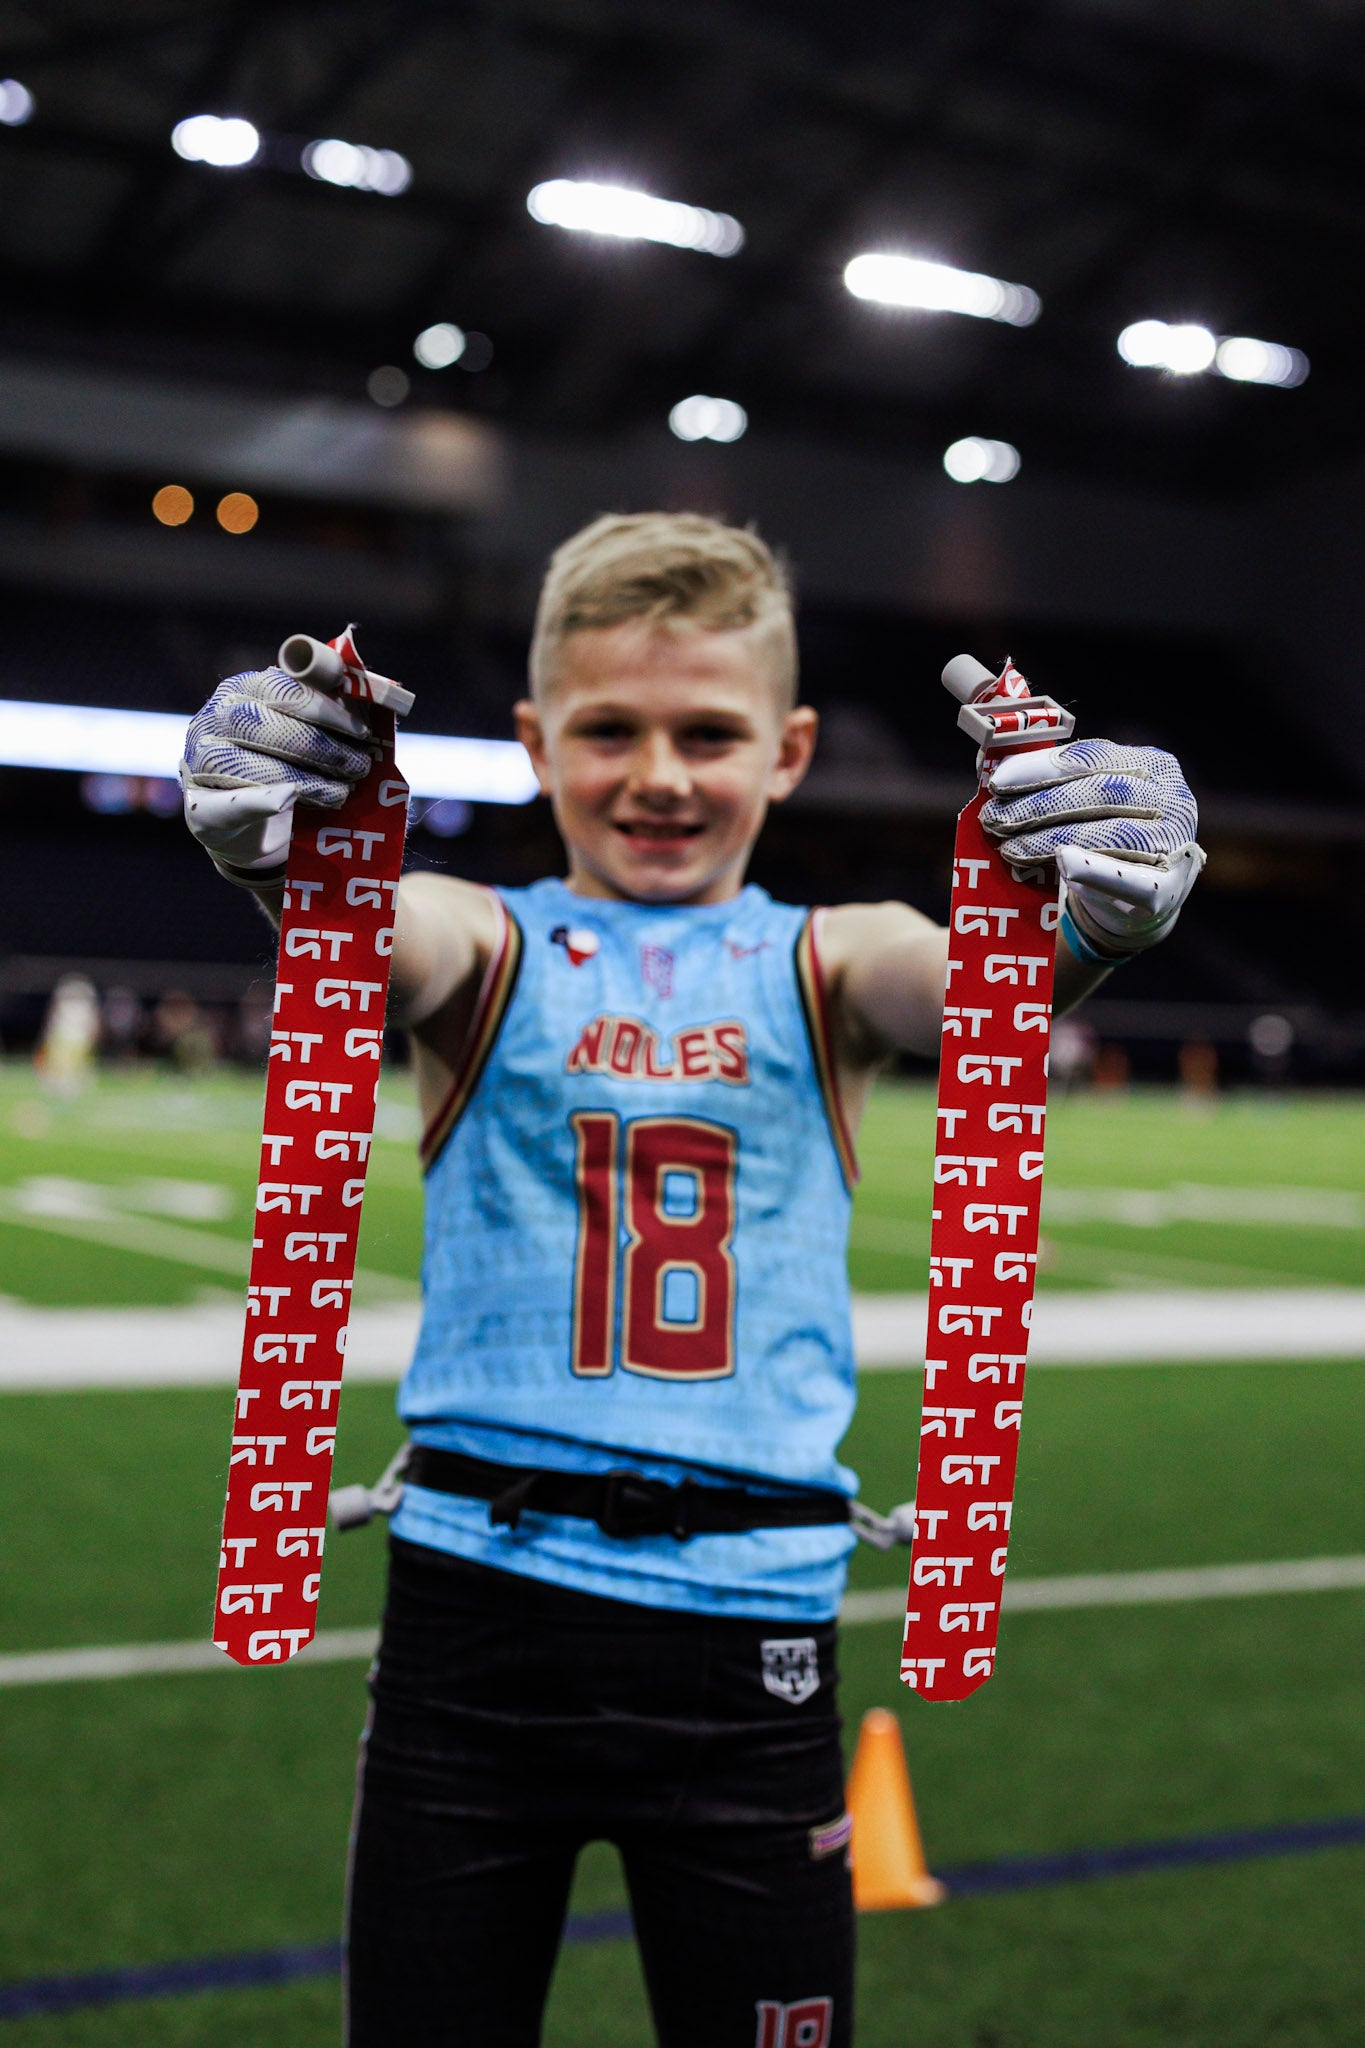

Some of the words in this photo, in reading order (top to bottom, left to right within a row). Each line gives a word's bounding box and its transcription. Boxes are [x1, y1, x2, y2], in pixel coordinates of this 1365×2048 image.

[317, 827, 384, 860] GT
[952, 857, 990, 888] T
[955, 906, 1019, 937] GT
[286, 928, 353, 961] GT
[984, 954, 1048, 985] GT
[315, 978, 382, 1011] GT
[1014, 1003, 1052, 1033] G
[344, 1028, 382, 1059] G
[566, 1015, 749, 1085] NOLES
[957, 1054, 1022, 1086] GT
[285, 1080, 353, 1113] GT
[988, 1103, 1046, 1134] GT
[315, 1130, 372, 1161] GT
[934, 1154, 997, 1186] GT
[256, 1182, 322, 1214] GT
[964, 1203, 1028, 1235] GT
[284, 1232, 347, 1262] GT
[570, 1108, 738, 1379] 18
[994, 1252, 1036, 1282] G
[311, 1280, 352, 1308] G
[938, 1305, 1002, 1336] GT
[254, 1334, 316, 1363] GT
[968, 1353, 1026, 1384] GT
[280, 1381, 341, 1409] GT
[941, 1455, 1000, 1485] GT
[250, 1482, 312, 1511] GT
[913, 1510, 948, 1539] T
[220, 1538, 257, 1568] T
[913, 1557, 973, 1586] GT
[220, 1584, 283, 1614] GT
[939, 1602, 995, 1632] GT
[248, 1628, 310, 1660] GT
